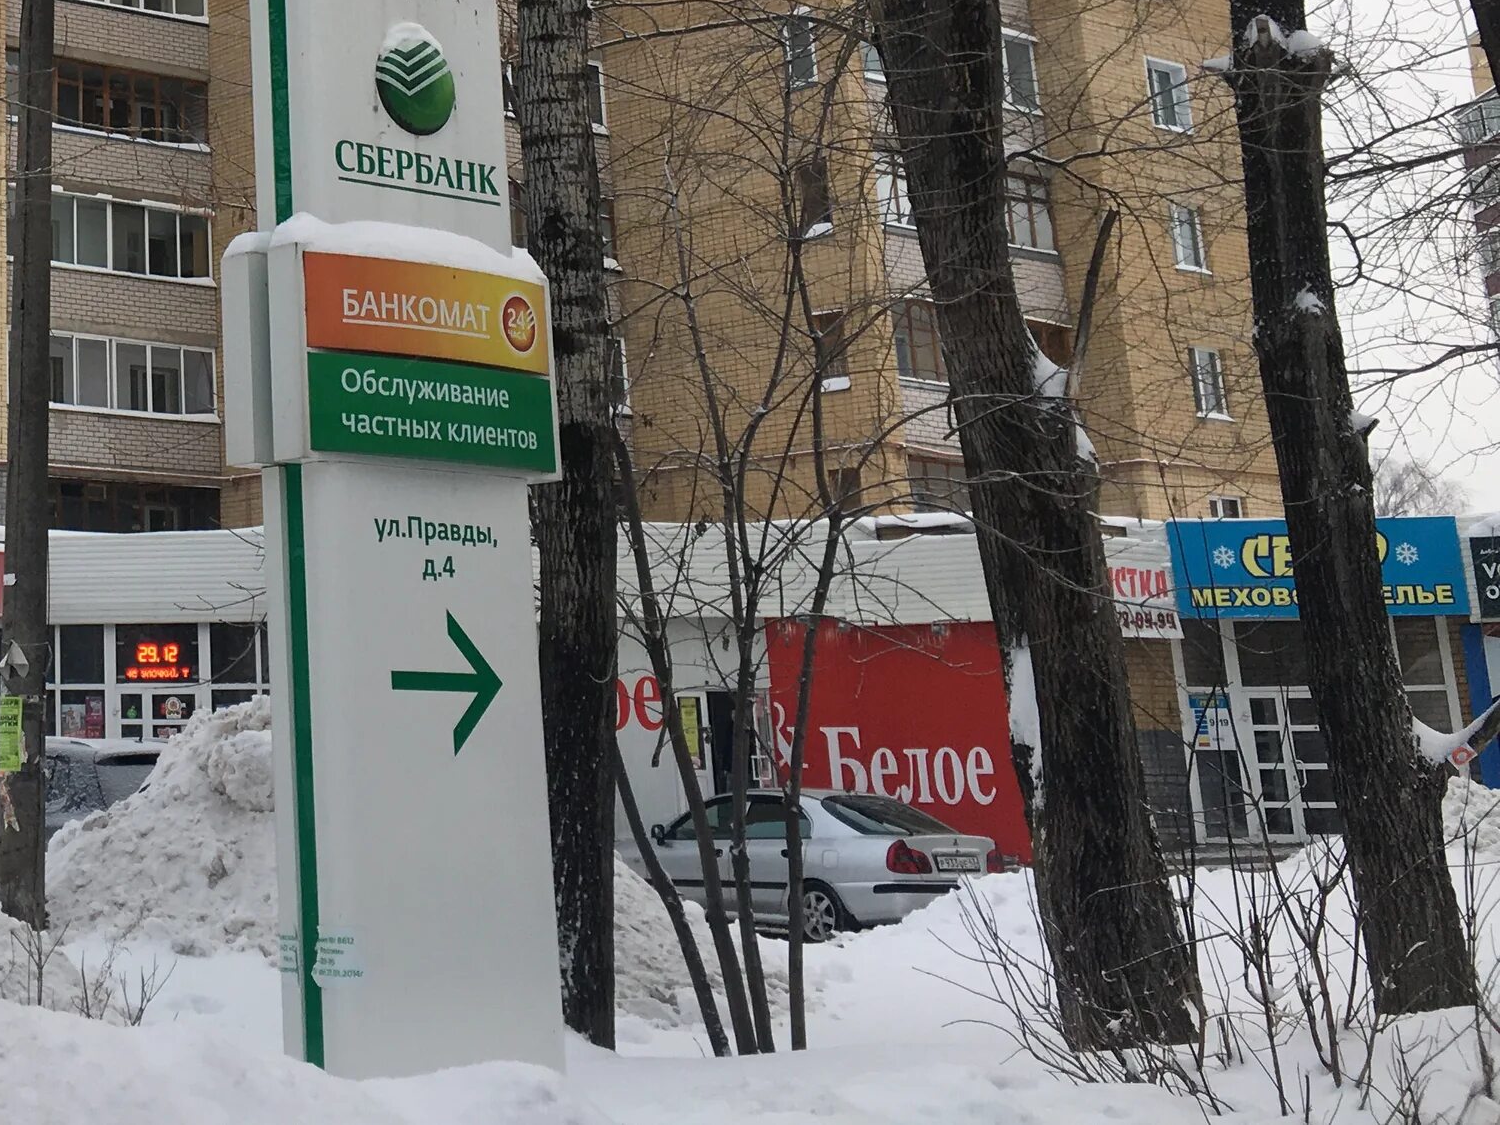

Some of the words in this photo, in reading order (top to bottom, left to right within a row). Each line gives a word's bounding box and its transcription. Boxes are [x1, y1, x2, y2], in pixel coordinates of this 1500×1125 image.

[335, 140, 500, 196] СБЕРБАНК
[342, 288, 491, 332] БАНКОМАТ
[341, 368, 510, 409] Обслуживание
[342, 412, 442, 441] частных
[448, 423, 538, 451] клиентов
[374, 515, 498, 548] ул.Правды,
[422, 555, 456, 581] д.4
[1382, 585, 1455, 605] ЕЛЬЕ
[820, 726, 997, 806] Белое
